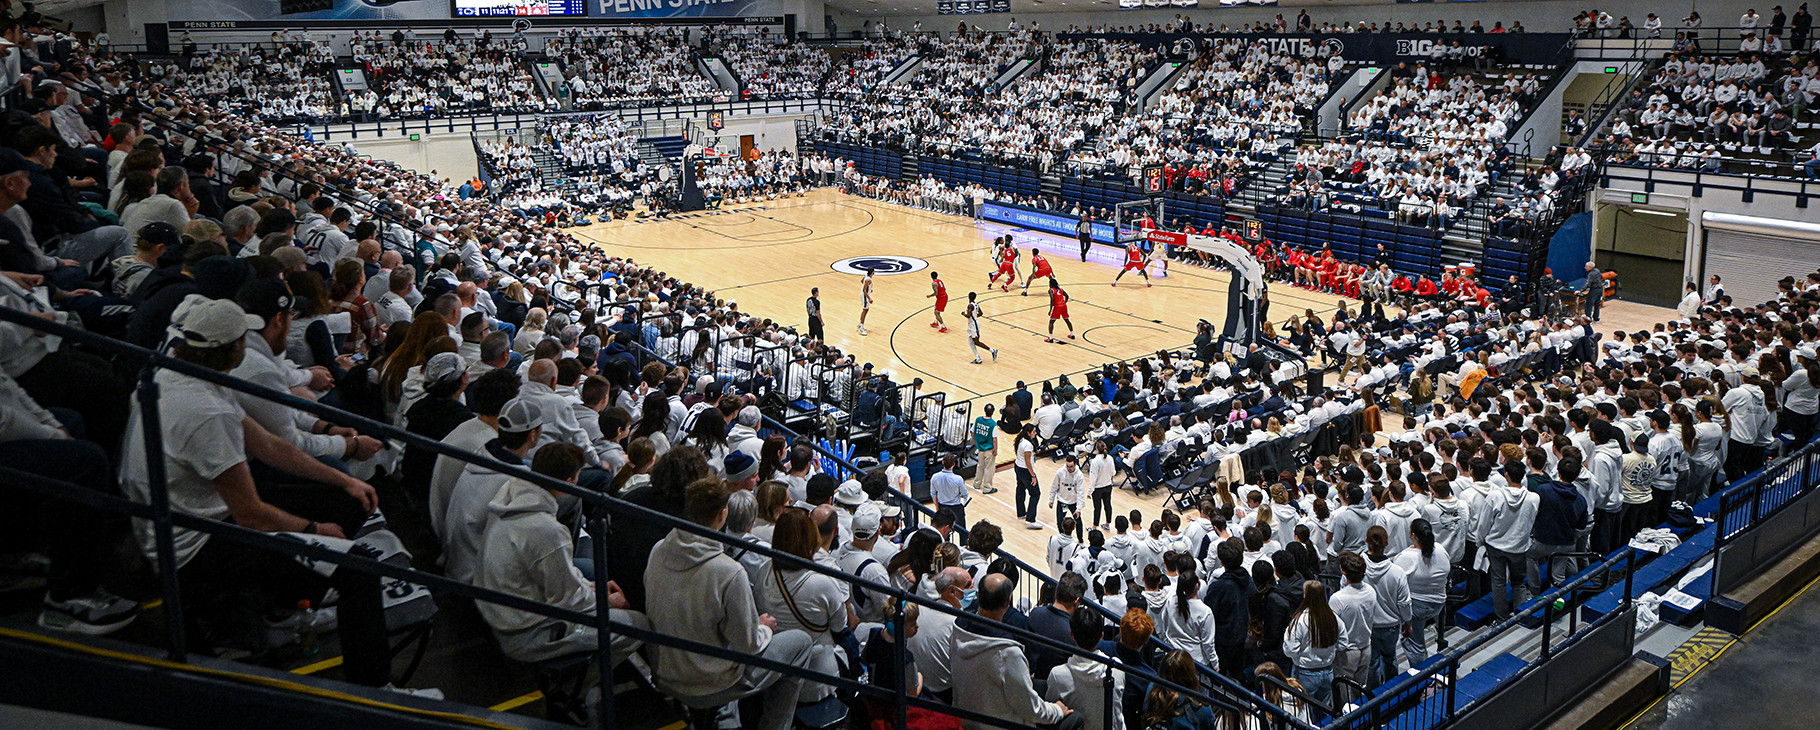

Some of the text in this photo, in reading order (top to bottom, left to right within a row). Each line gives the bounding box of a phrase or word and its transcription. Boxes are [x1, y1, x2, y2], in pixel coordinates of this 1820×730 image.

[1150, 177, 1160, 191] 15
[308, 228, 327, 252] 70
[1056, 547, 1064, 566] 1
[1086, 560, 1097, 577] 4
